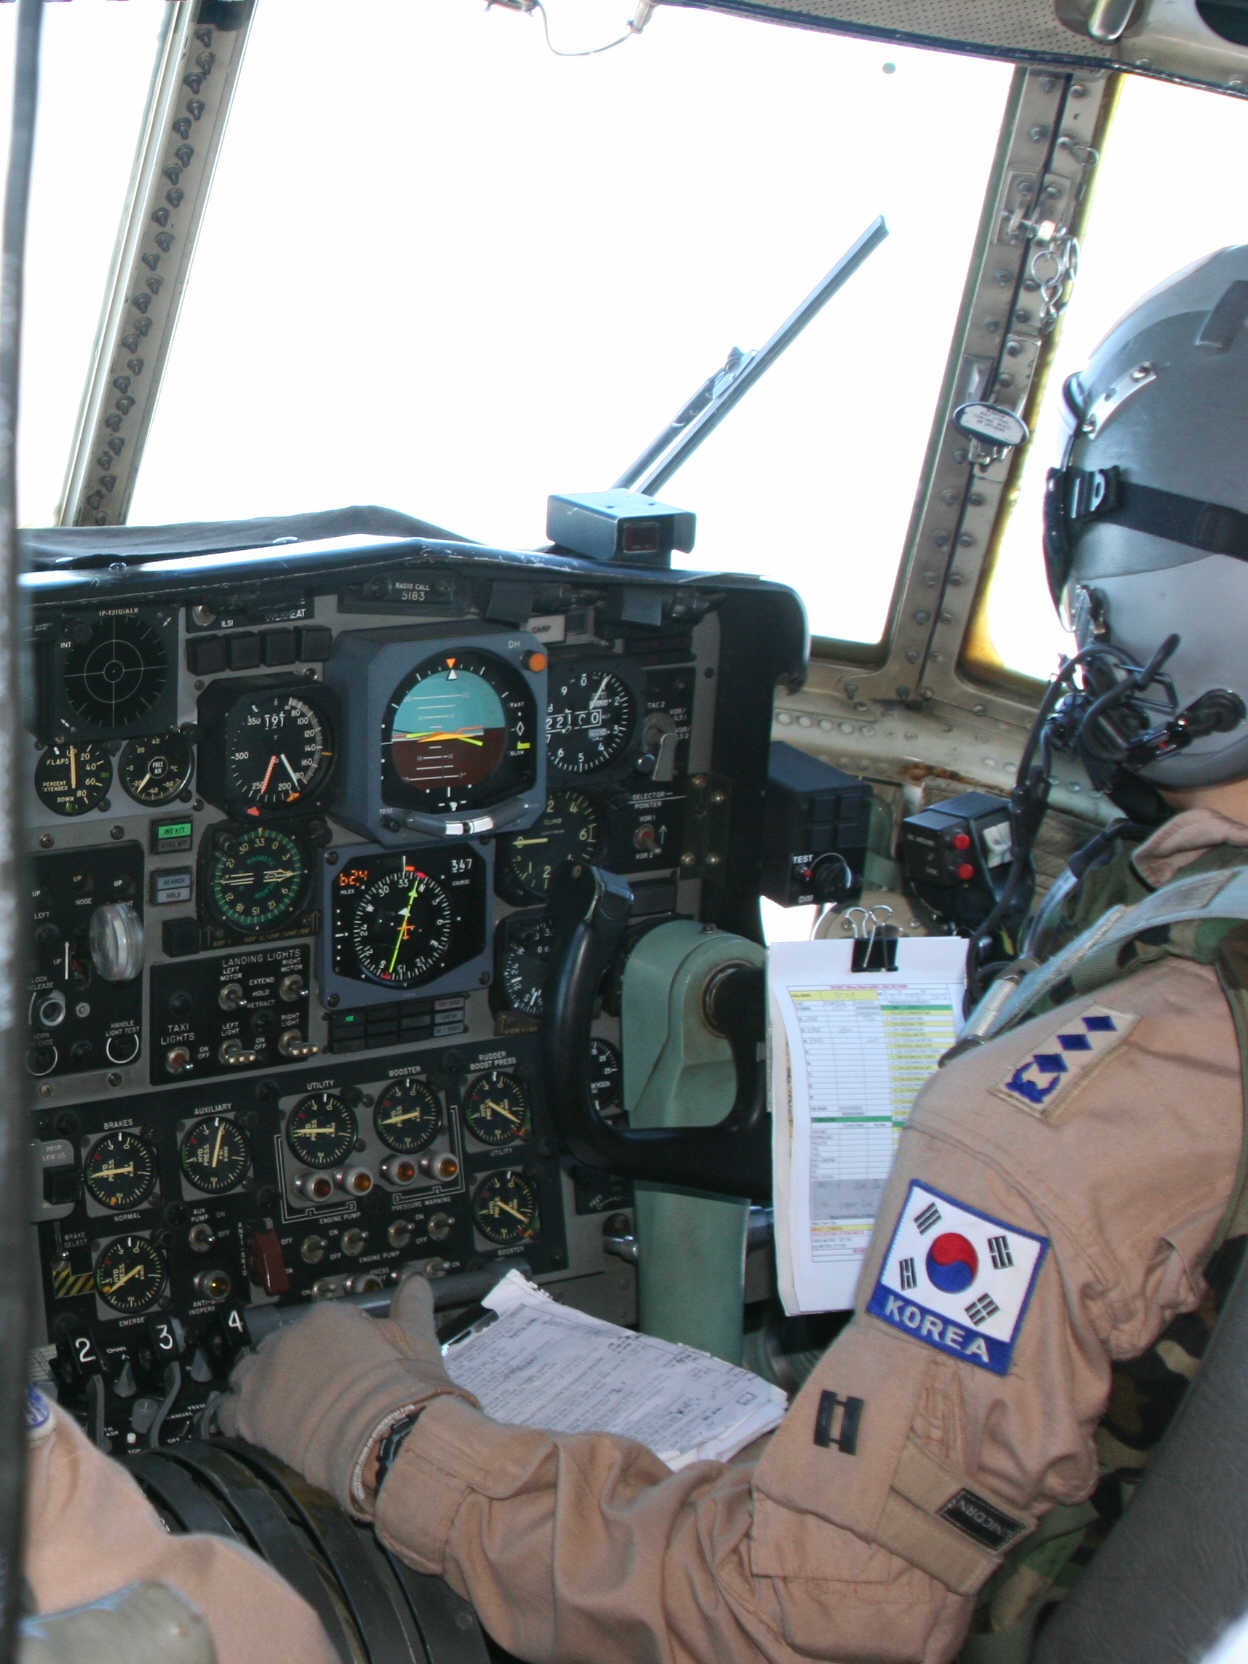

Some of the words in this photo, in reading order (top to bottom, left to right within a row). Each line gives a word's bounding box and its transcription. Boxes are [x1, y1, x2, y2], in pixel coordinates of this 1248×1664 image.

[401, 591, 426, 601] 5183
[508, 640, 520, 648] DH
[47, 758, 69, 766] FLAPS
[86, 763, 96, 771] 40
[792, 855, 813, 864] TEST
[222, 954, 264, 968] LANDING
[267, 949, 301, 961] LIGHTS
[125, 1026, 140, 1034] TEST
[168, 1024, 189, 1033] TAXI
[161, 1033, 195, 1045] LIGHTS
[388, 1066, 422, 1078] BOOSTER
[306, 1080, 335, 1091] UTILITY
[194, 1103, 233, 1115] AUXILIARY
[104, 1119, 134, 1130] BRAKES
[114, 1213, 141, 1222] NORMAL
[228, 1309, 244, 1333] 4
[885, 1295, 990, 1362] KOREA
[157, 1323, 173, 1350] 3
[75, 1337, 97, 1363] 2
